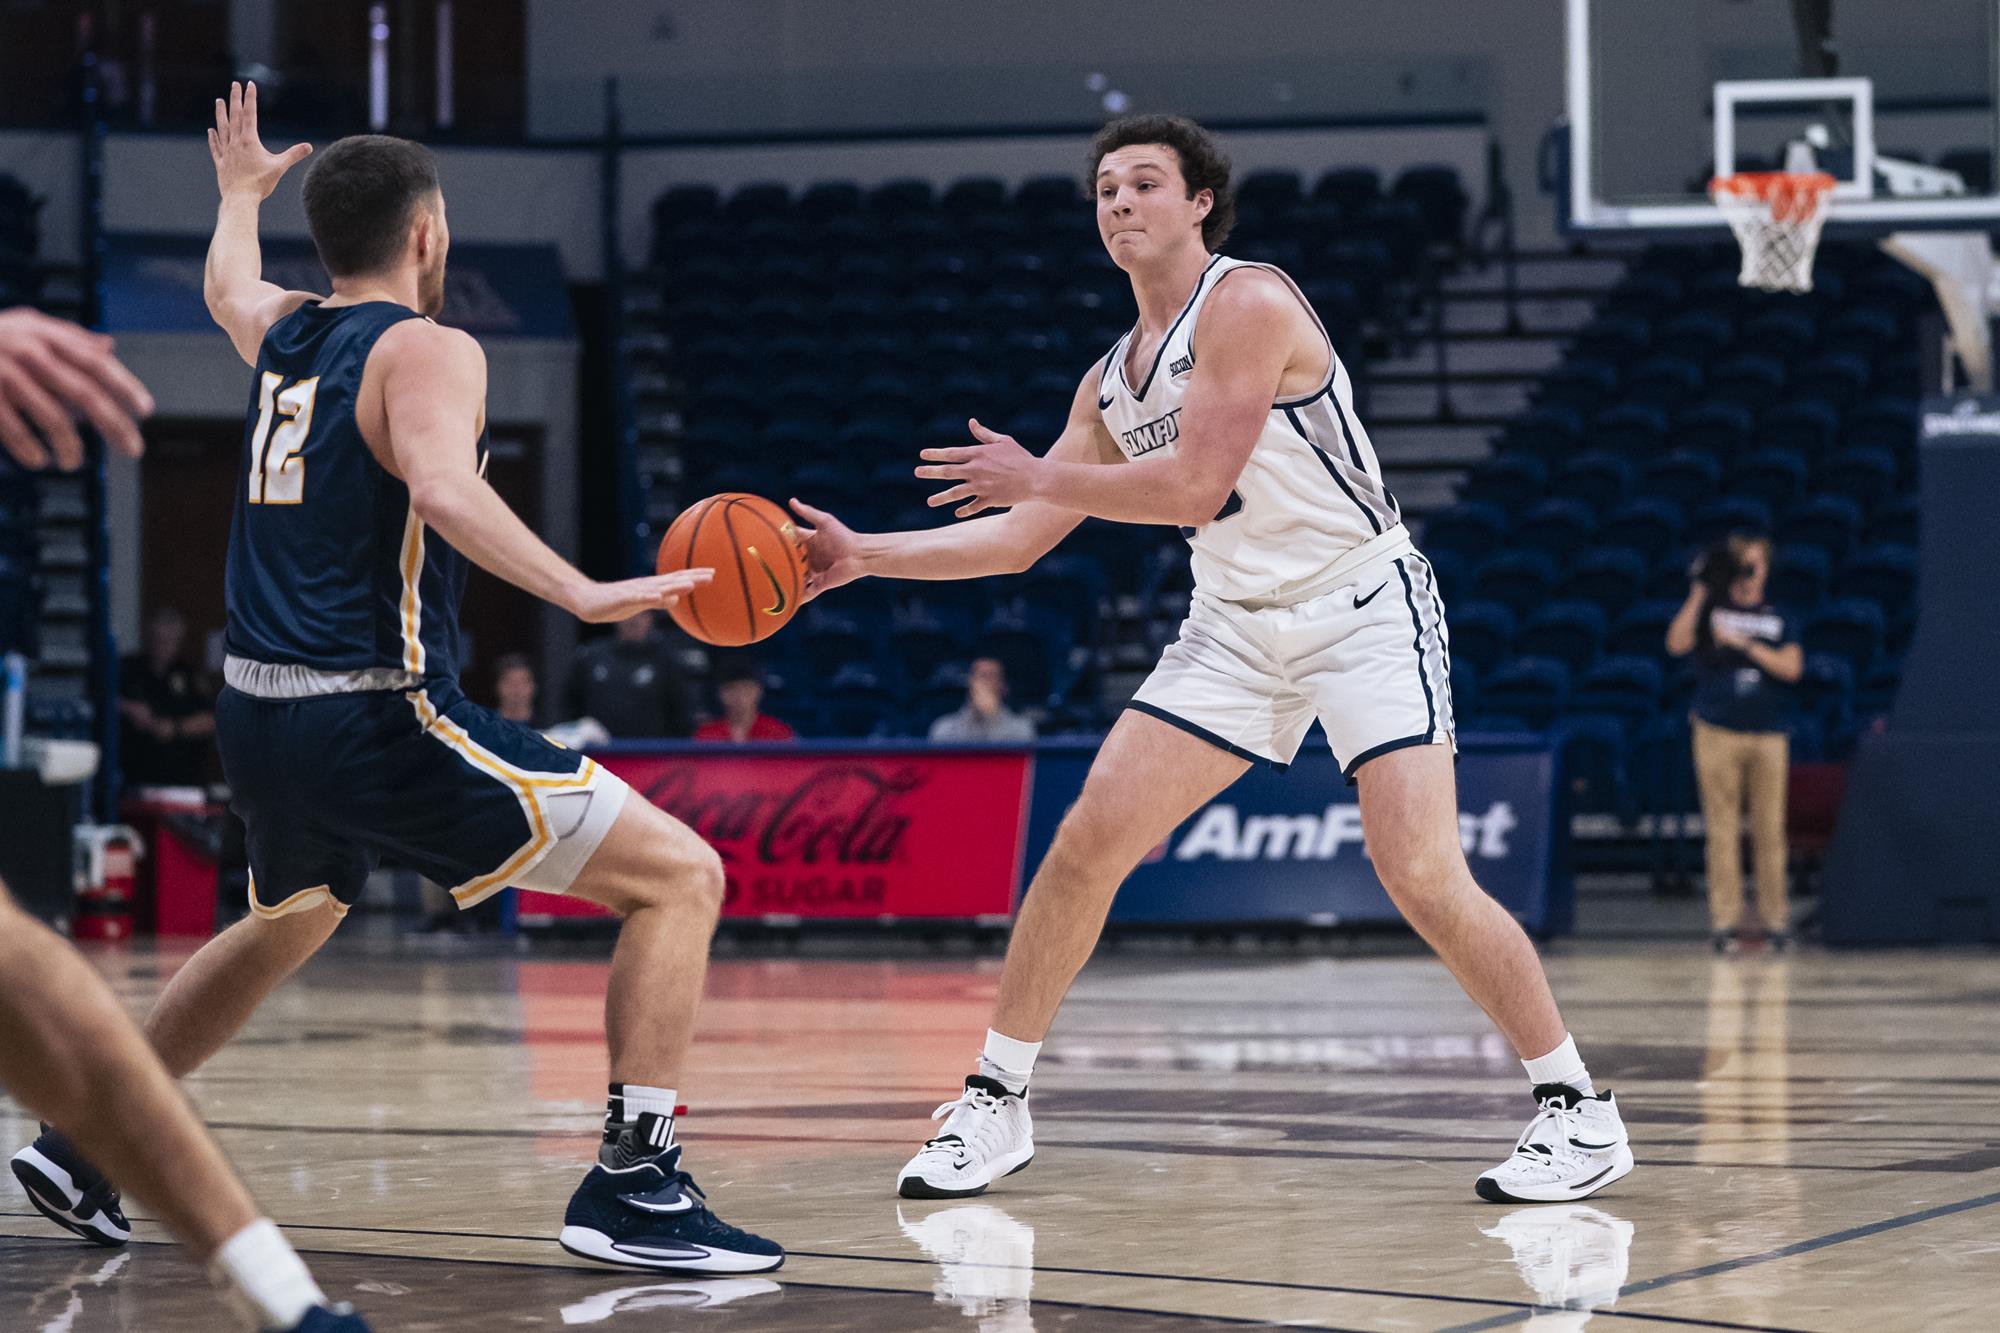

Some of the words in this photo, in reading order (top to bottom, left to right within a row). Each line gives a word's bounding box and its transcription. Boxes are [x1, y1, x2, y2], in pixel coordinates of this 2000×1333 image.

[249, 370, 320, 504] 12
[1175, 803, 1515, 858] AmFst
[751, 876, 887, 906] SUGAR
